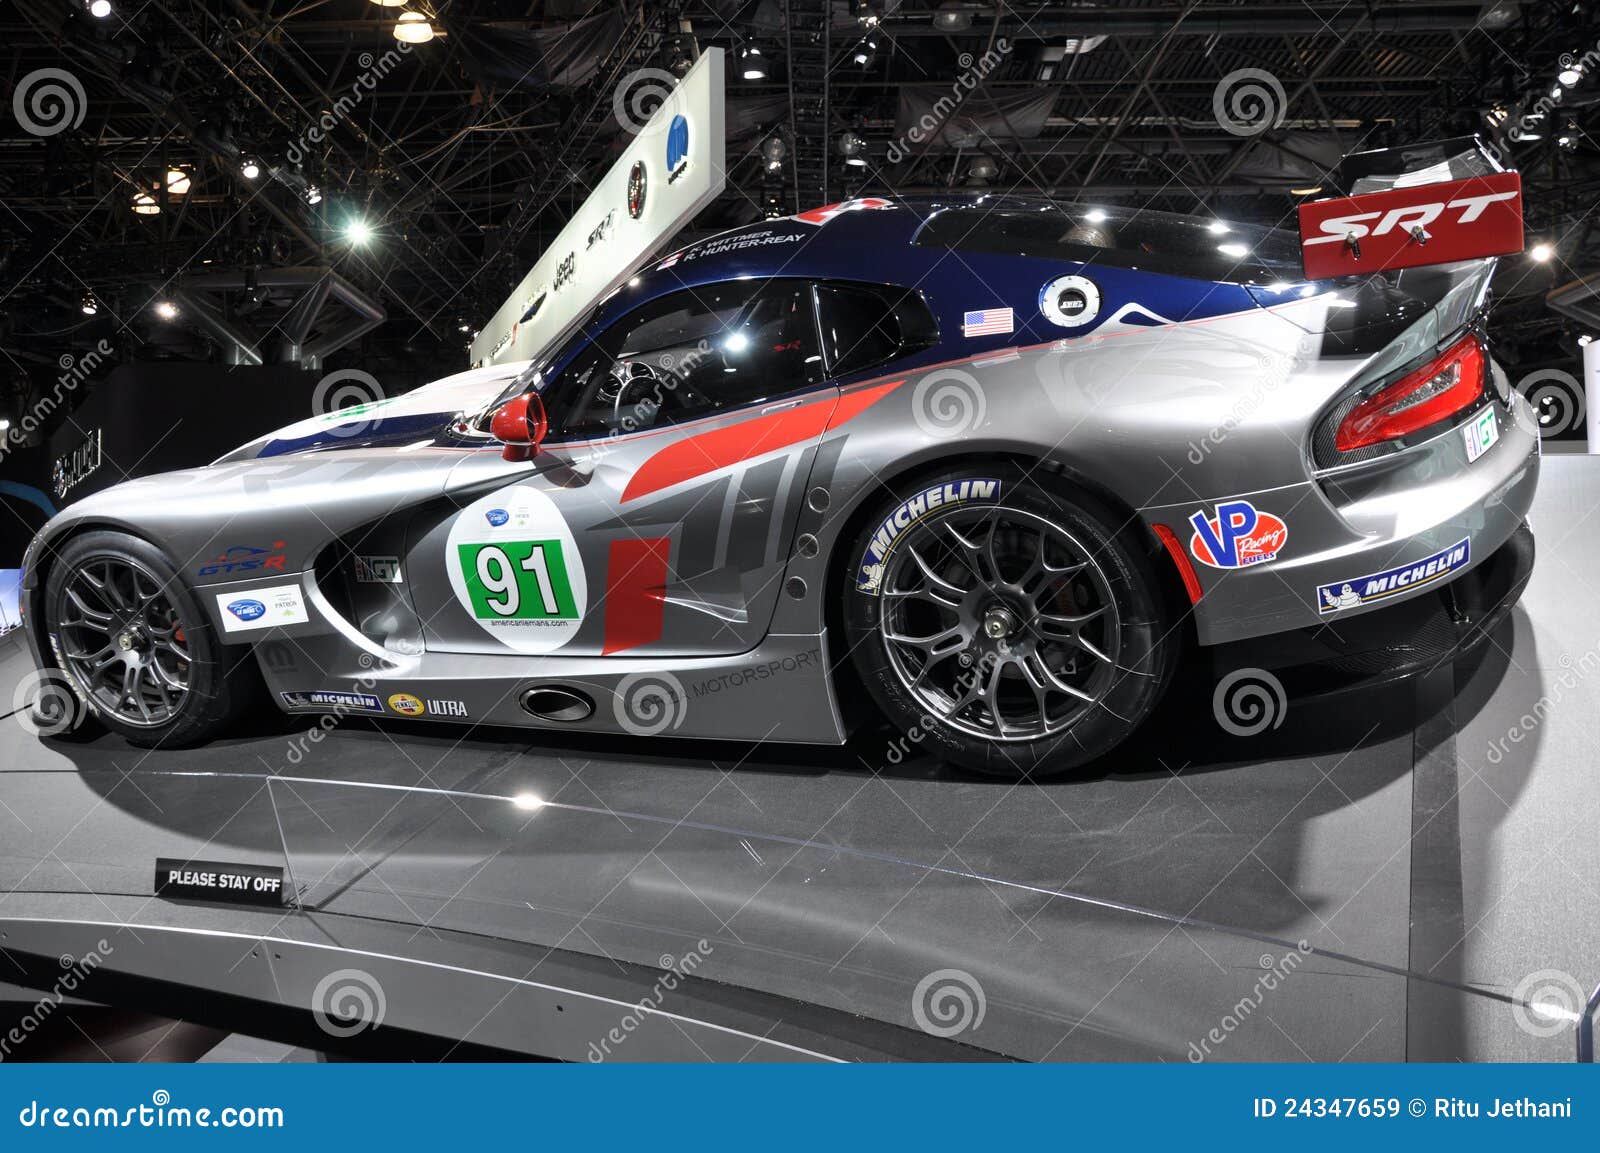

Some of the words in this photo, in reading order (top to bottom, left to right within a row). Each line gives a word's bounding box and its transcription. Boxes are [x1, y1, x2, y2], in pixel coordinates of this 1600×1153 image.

[1302, 191, 1519, 246] SRT
[700, 233, 805, 257] HUNTER-REAY
[706, 230, 773, 248] WITTMER
[553, 251, 574, 291] Jeep
[869, 481, 996, 561] MICHELIN
[1190, 500, 1258, 568] VP
[1239, 528, 1285, 557] Racing
[198, 555, 287, 577] GTS-R
[1242, 552, 1275, 565] FUELS
[1365, 546, 1466, 596] MICHELIN
[475, 543, 560, 617] 91
[491, 619, 568, 628] americanlemans.com
[693, 649, 820, 697] MOTORSPORT
[311, 693, 376, 708] MICHELIN
[427, 699, 468, 717] ULTRA
[168, 870, 217, 887] PLEASE
[218, 874, 251, 889] STAY
[253, 877, 281, 892] OFF
